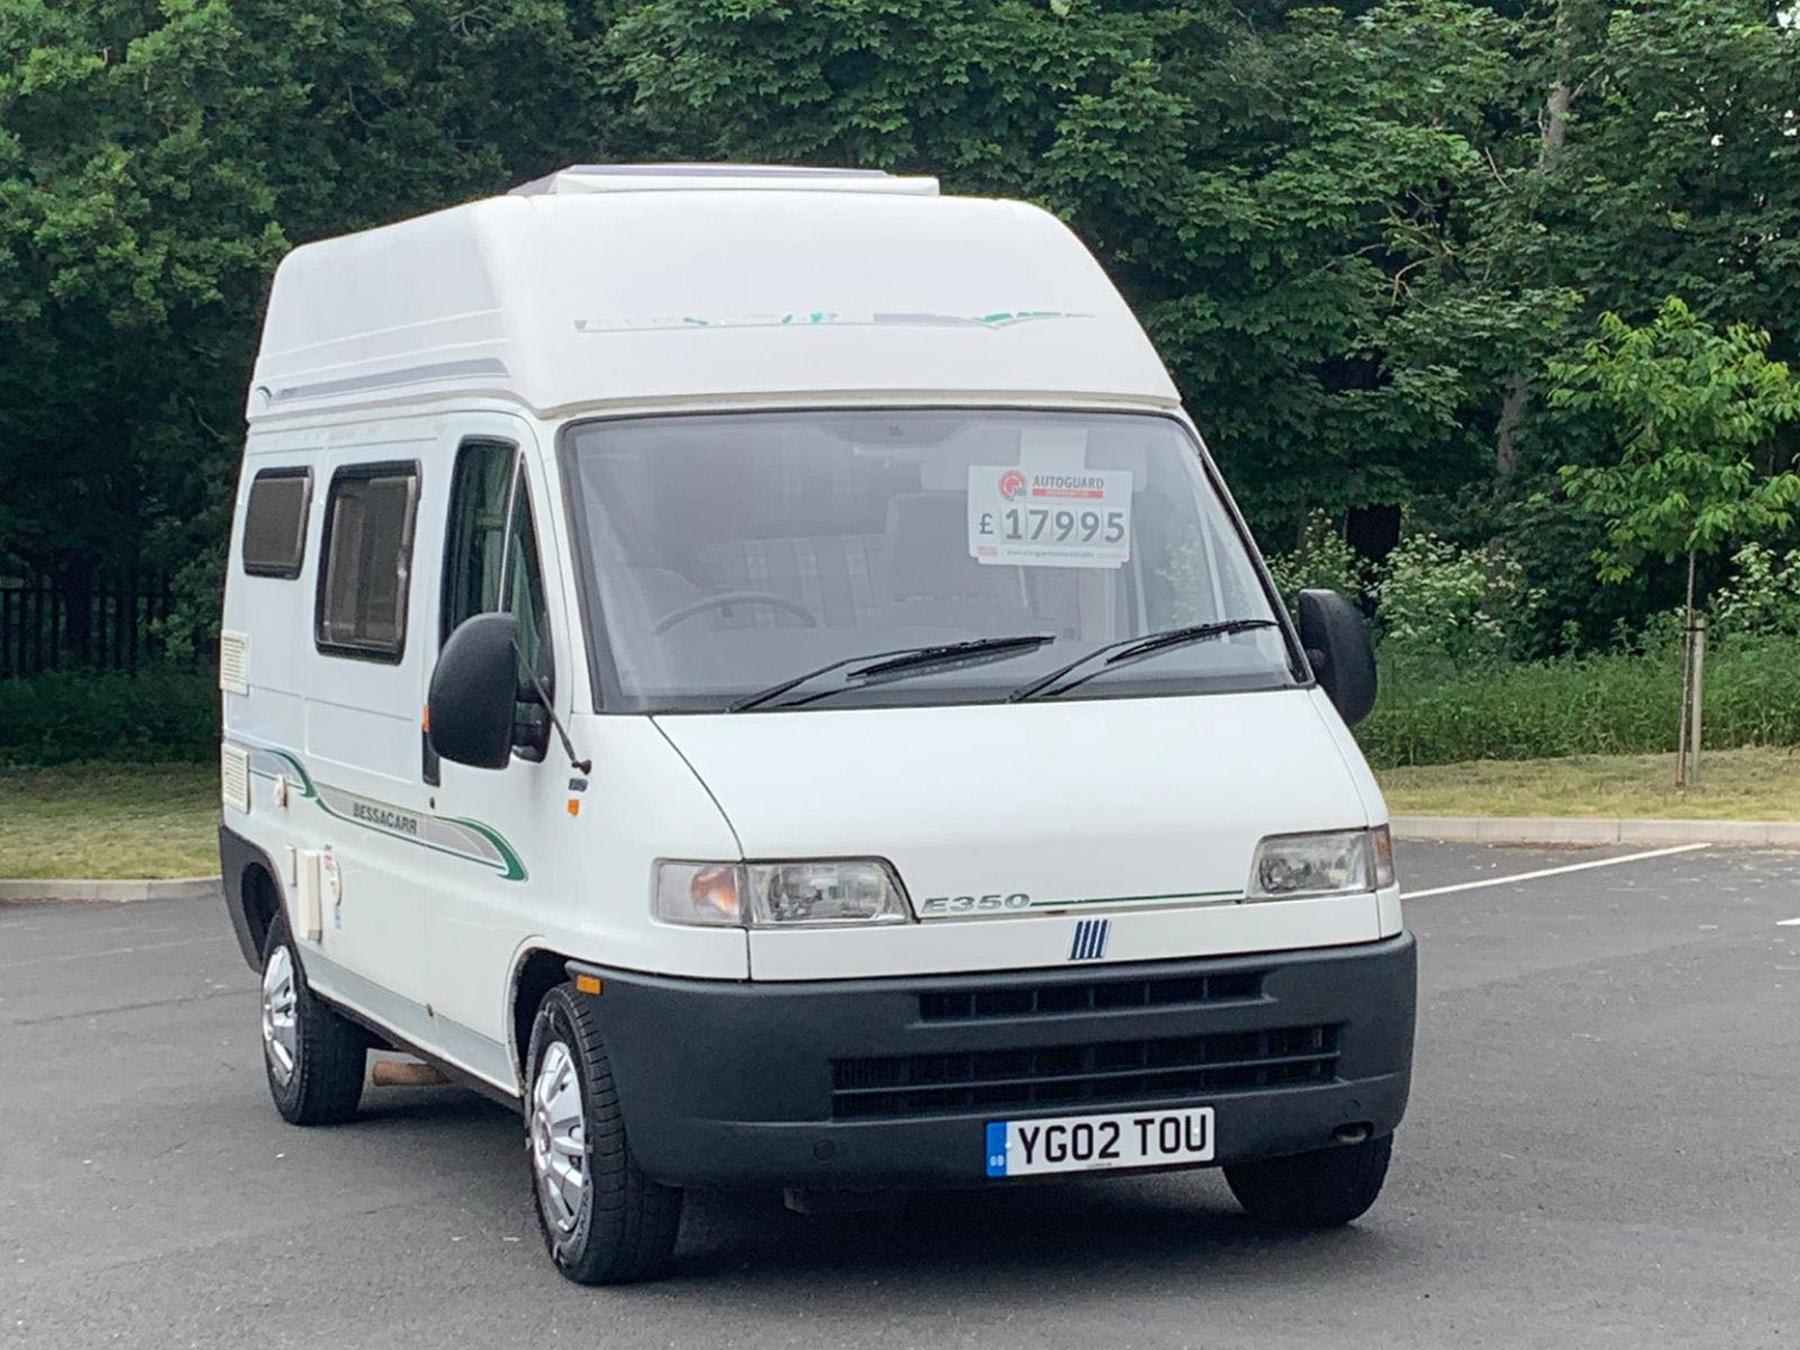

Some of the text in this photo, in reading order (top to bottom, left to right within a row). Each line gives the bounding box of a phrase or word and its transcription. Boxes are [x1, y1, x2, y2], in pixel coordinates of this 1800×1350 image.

[1033, 475, 1104, 489] AUTOGUARD
[1005, 509, 1125, 542] 17995
[353, 803, 417, 835] BESSACARR
[922, 893, 1031, 914] E350
[1018, 1114, 1207, 1165] YG02 TOU
